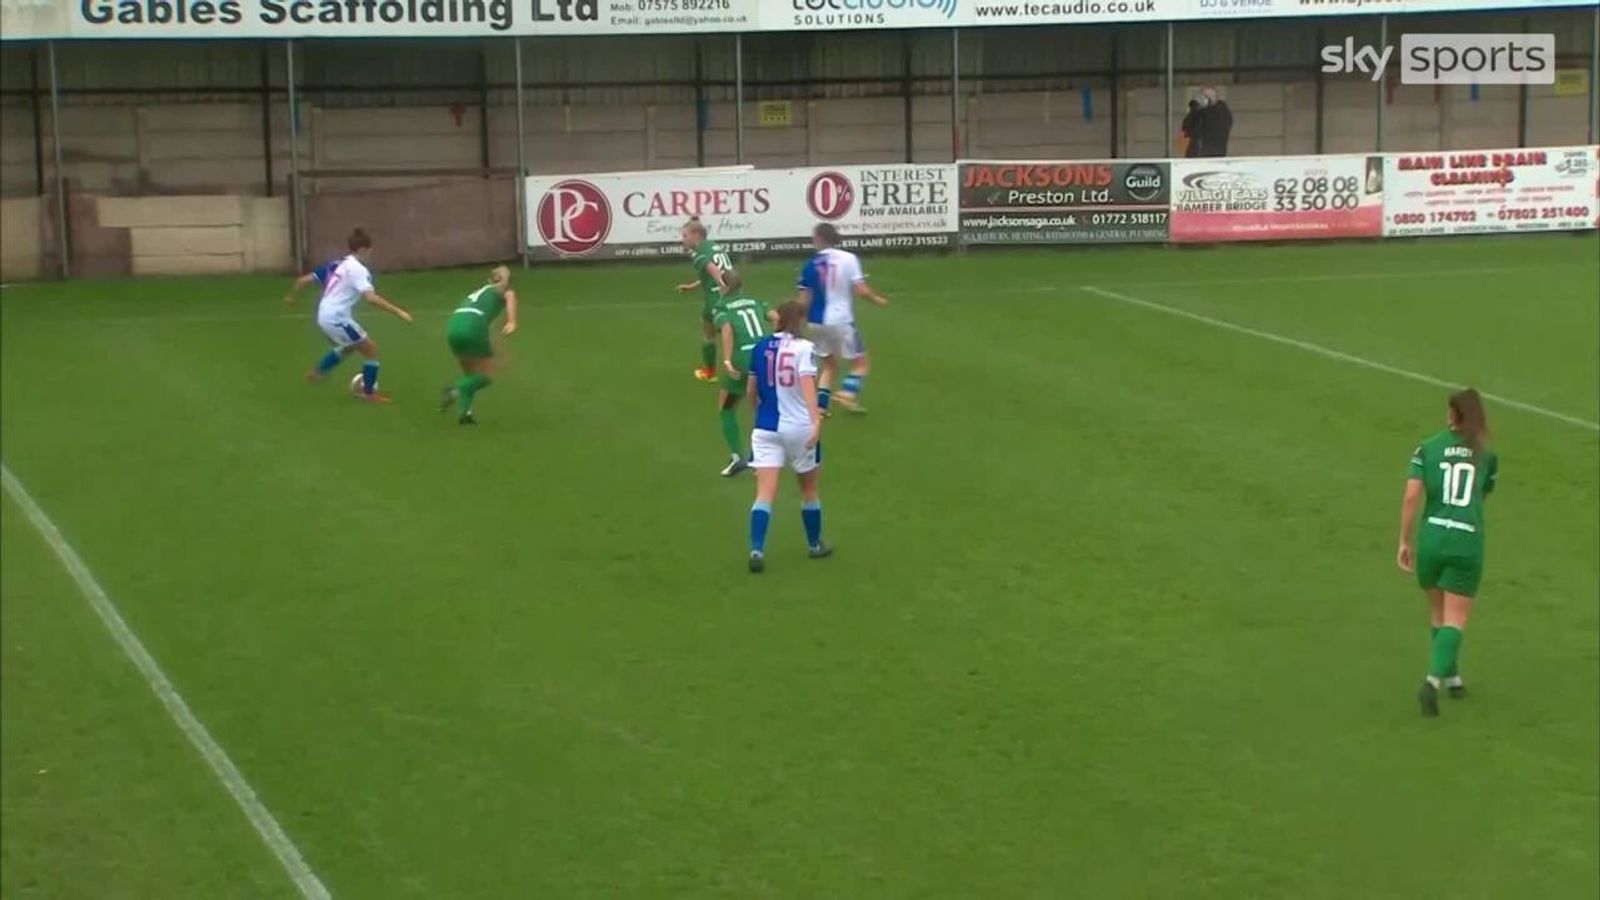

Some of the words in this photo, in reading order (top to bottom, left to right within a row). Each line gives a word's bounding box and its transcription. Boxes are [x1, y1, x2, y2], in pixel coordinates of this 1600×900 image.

[638, 0, 678, 10] 07575
[682, 0, 730, 10] 892216
[976, 2, 1157, 17] www.tecaudio.co.uk
[81, 0, 242, 24] Gables
[259, 0, 513, 31] Scaffolding
[531, 0, 599, 21] Ltd
[794, 13, 885, 25] SOLUTIONS
[1397, 156, 1445, 170] MAIN
[1450, 154, 1487, 168] LINE
[1492, 151, 1548, 166] DRAIN
[860, 168, 948, 182] INTEREST
[963, 164, 1114, 188] JACKSONS
[1126, 175, 1161, 188] Guild
[1274, 178, 1298, 194] 62
[1303, 177, 1328, 194] 08
[1333, 176, 1359, 193] 08
[814, 176, 851, 215] 0%
[861, 182, 949, 206] FREE
[1008, 190, 1075, 205] Preston
[1081, 189, 1115, 204] Ltd.
[1274, 194, 1297, 211] 33
[1301, 194, 1327, 211] 50
[1331, 193, 1359, 210] 00
[622, 188, 771, 218] CARPETS
[859, 206, 885, 217] NOW
[888, 205, 948, 216] AVAILABLE!
[1176, 202, 1222, 213] BAMBER
[1226, 201, 1268, 211] BRIDGE
[963, 214, 1076, 230] www.jacksonsaga.co.uk
[1092, 213, 1127, 225] 01772
[1131, 212, 1168, 224] 518117
[1394, 212, 1425, 225] 0800
[1541, 206, 1589, 219] 251400
[860, 238, 883, 248] LANE
[737, 309, 763, 338] 11
[764, 350, 795, 387] 15
[1444, 447, 1473, 457] HARDY
[1439, 462, 1475, 507] 10
